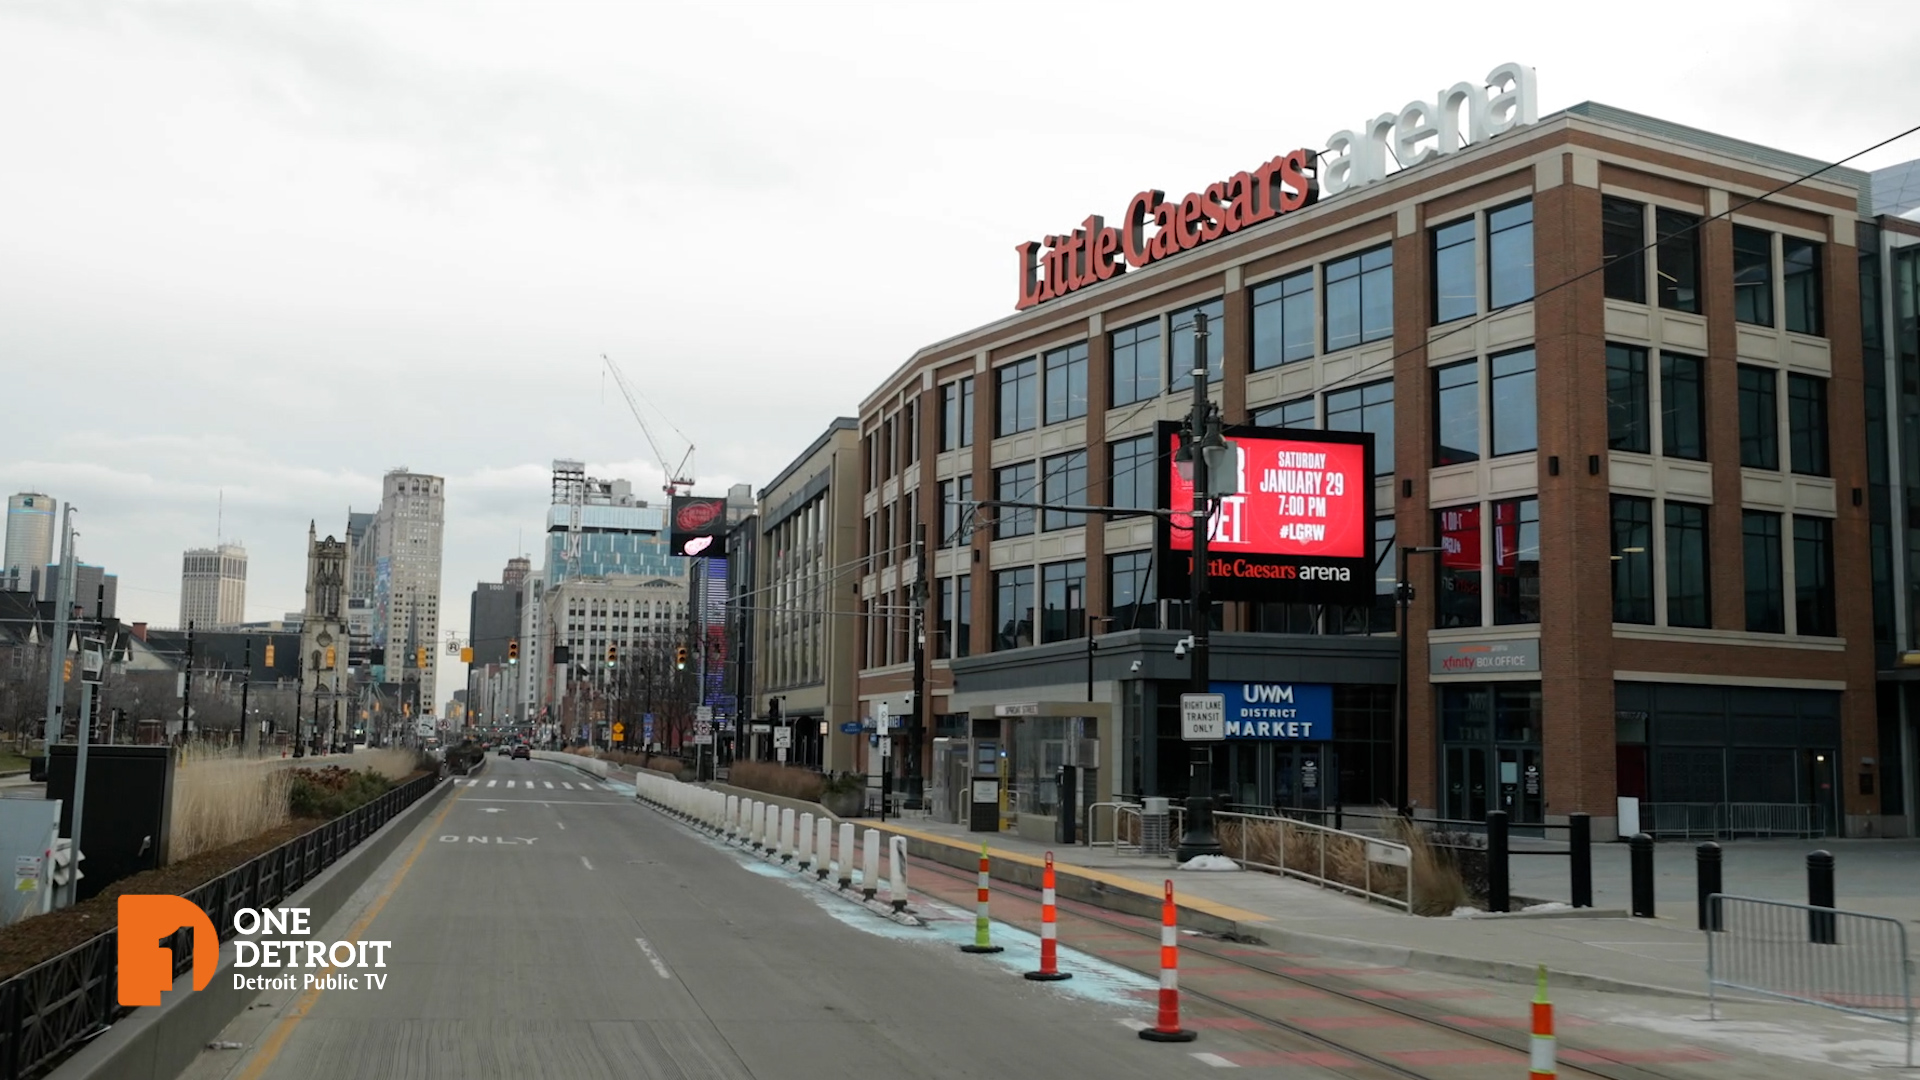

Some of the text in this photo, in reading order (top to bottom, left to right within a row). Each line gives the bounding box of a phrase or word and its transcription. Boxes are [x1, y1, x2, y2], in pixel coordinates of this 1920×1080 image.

[1015, 62, 1538, 310] Little Caesars arena
[1278, 451, 1326, 469] SATURDAY
[1259, 469, 1323, 495] JANUARY
[1325, 472, 1344, 496] 29
[1278, 495, 1326, 517] 7:00 PM
[1279, 523, 1326, 541] #LGRW
[1187, 557, 1351, 581] ttle Caesars arena
[1442, 655, 1525, 670] xfinity BOX OFFICE
[1243, 684, 1294, 704] UWM
[1184, 701, 1222, 710] RIGHT LANE
[1240, 708, 1297, 718] DISTRICT
[1186, 712, 1220, 721] TRANSIT
[1193, 724, 1213, 733] ONLY
[1225, 720, 1313, 738] MARKET
[439, 835, 539, 845] ONLY
